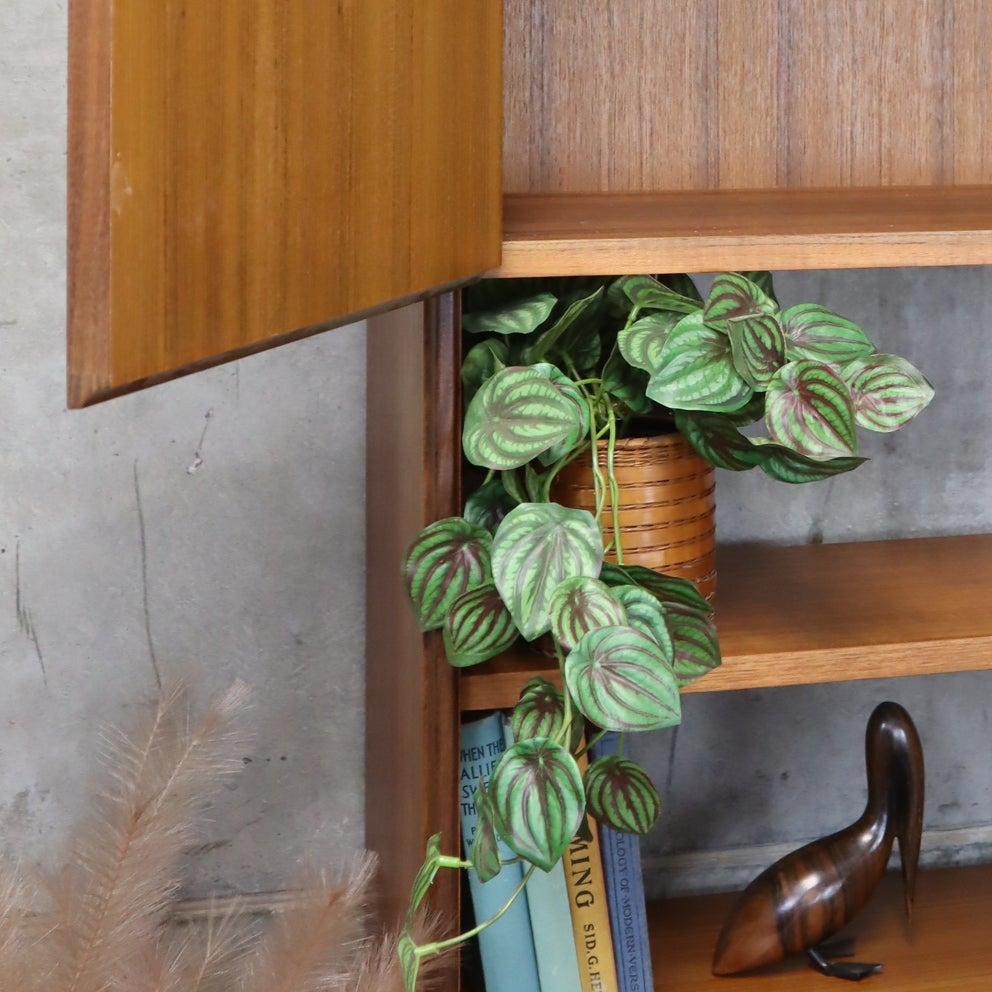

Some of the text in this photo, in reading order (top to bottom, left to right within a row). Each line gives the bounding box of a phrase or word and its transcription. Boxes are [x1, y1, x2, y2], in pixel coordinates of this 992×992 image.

[461, 760, 497, 780] ALLIE
[569, 835, 594, 909] MING
[615, 831, 628, 873] OLOGY
[628, 956, 640, 992] VERS
